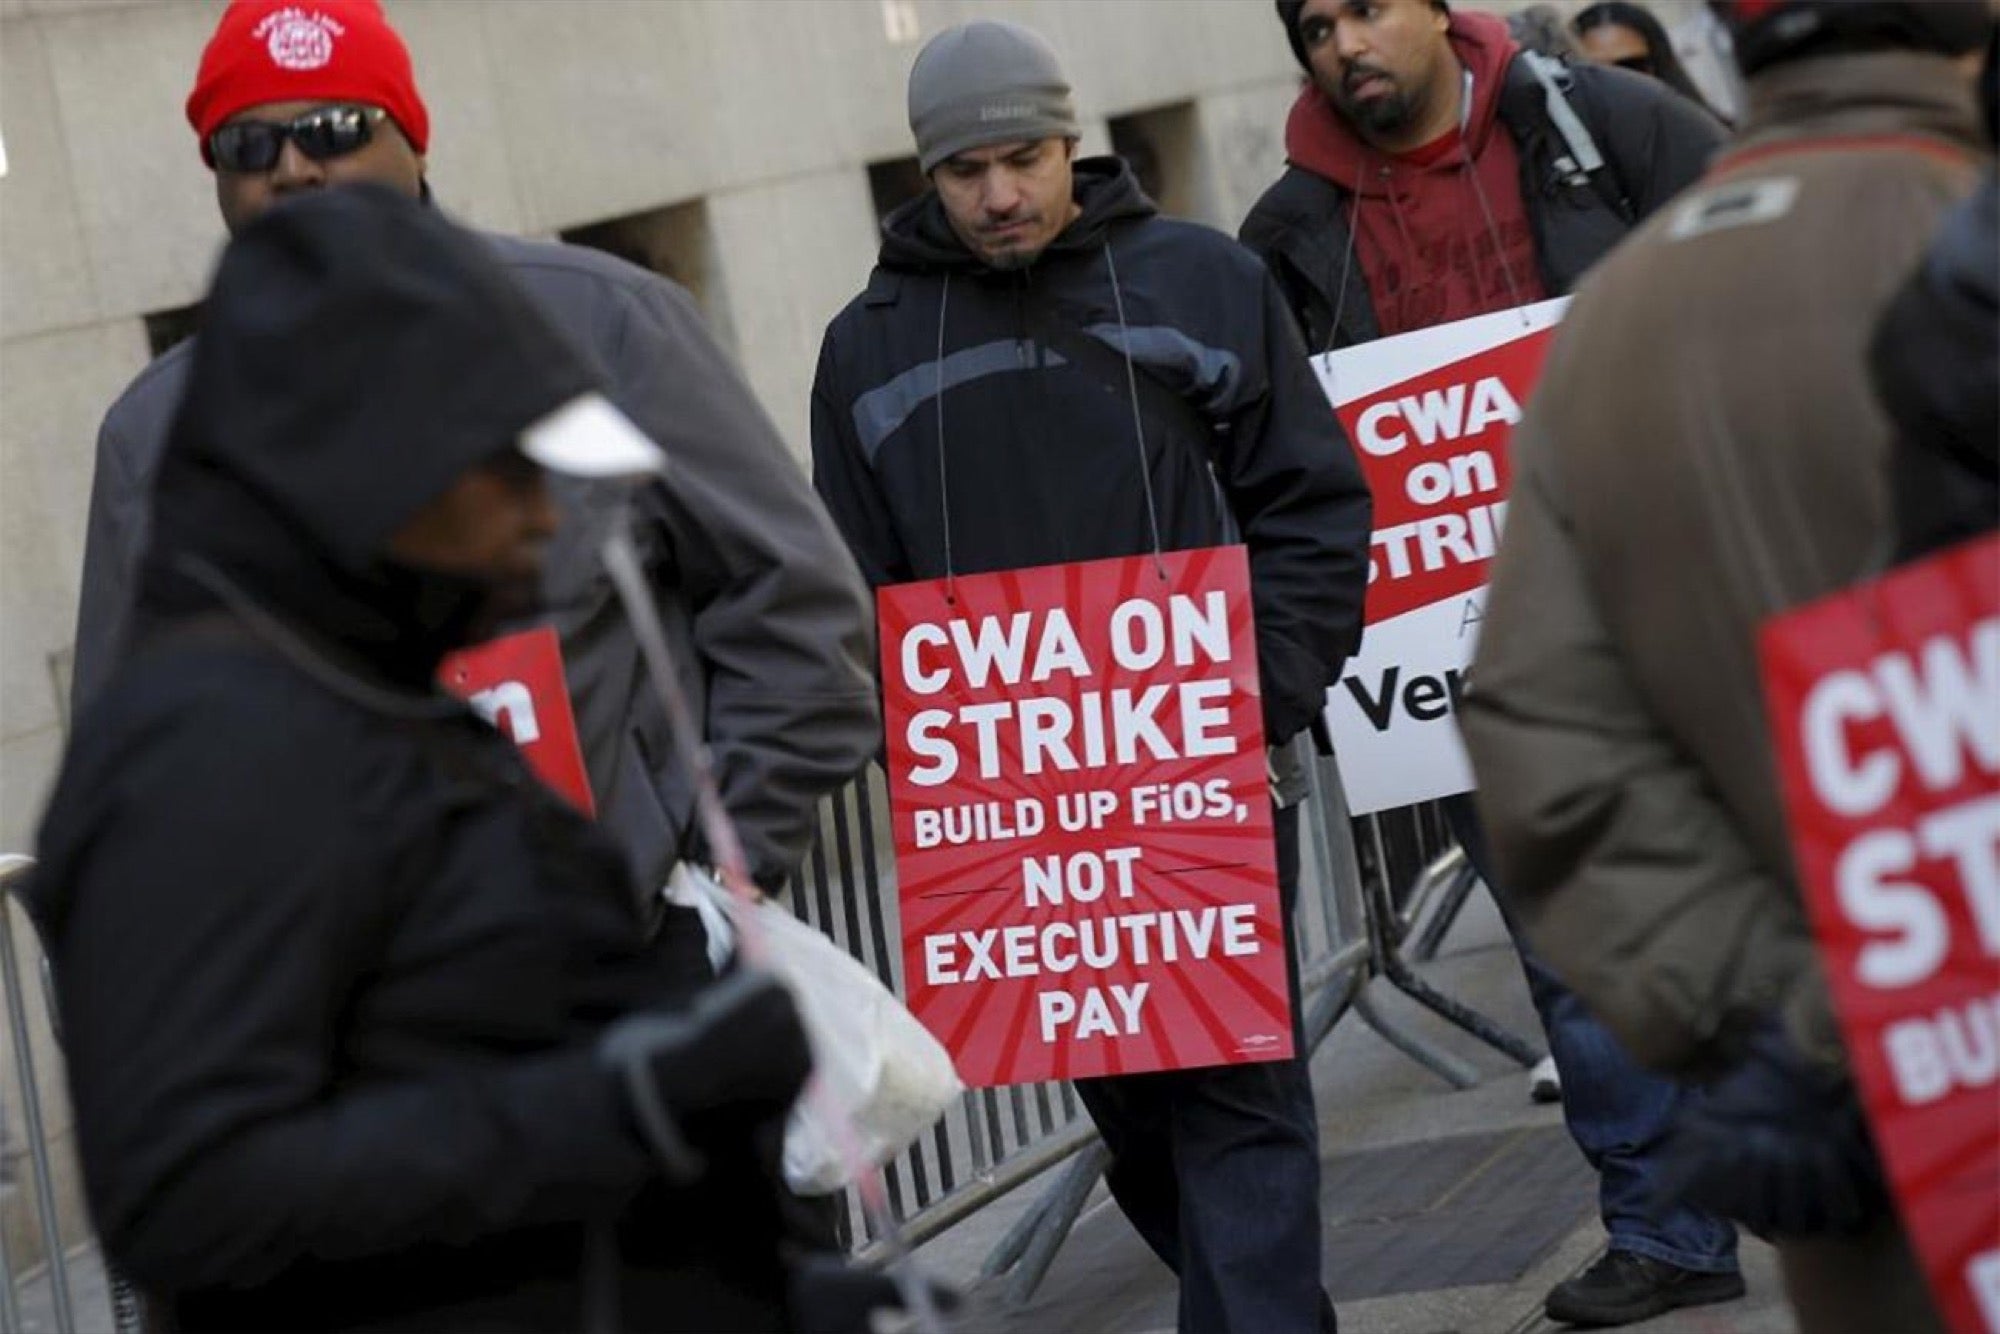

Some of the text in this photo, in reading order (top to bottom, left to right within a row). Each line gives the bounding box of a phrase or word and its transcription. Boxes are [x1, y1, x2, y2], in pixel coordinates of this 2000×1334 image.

[1355, 376, 1522, 457] CWA
[1405, 450, 1498, 506] on
[1367, 501, 1508, 584] TRI
[901, 590, 1232, 695] CWA ON
[906, 677, 1238, 787] STRIKE
[914, 779, 1249, 849] BUILD UP FiOS,
[1022, 846, 1143, 908] NOT
[924, 903, 1261, 986] EXECUTIVE
[1038, 982, 1150, 1043] PAY
[1884, 997, 2000, 1103] BU
